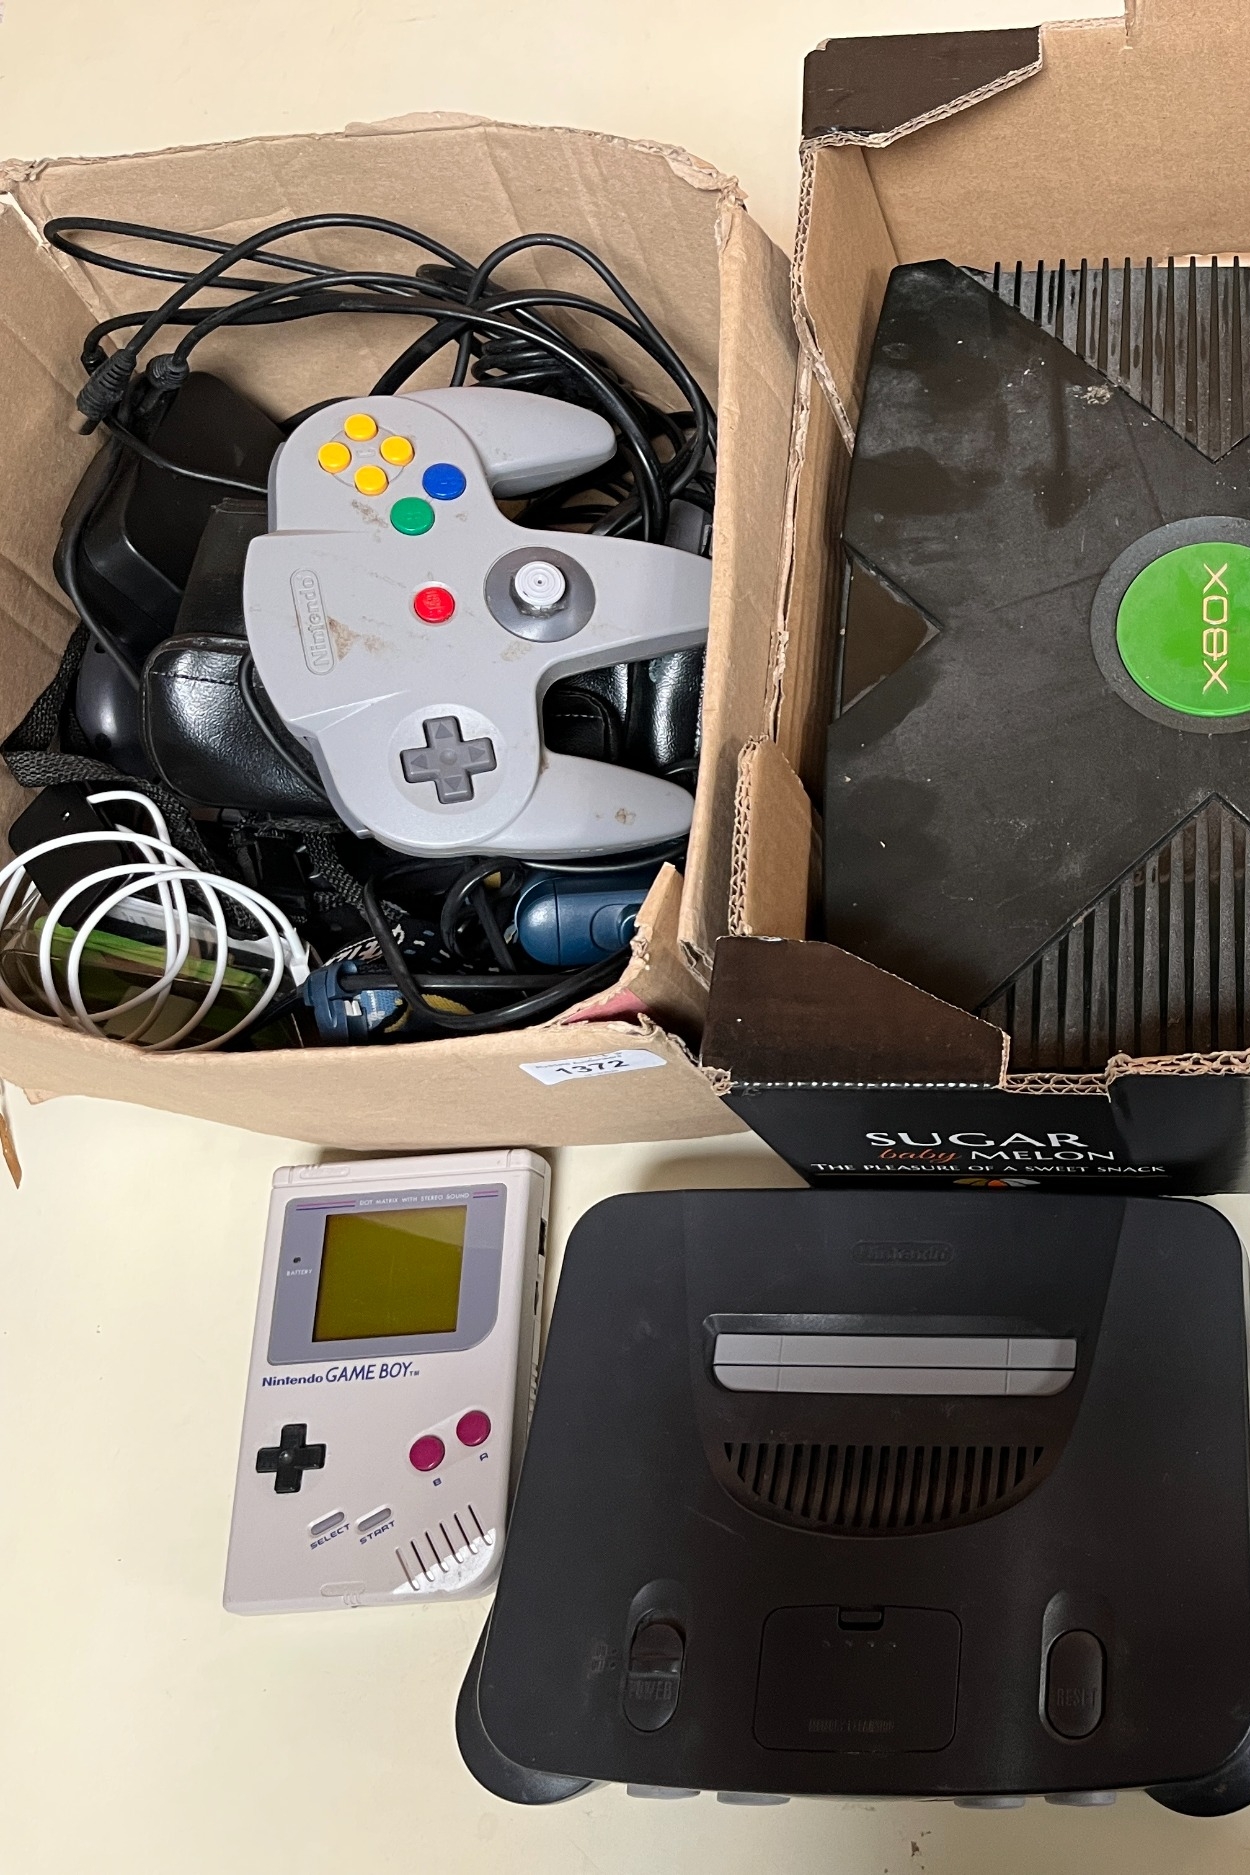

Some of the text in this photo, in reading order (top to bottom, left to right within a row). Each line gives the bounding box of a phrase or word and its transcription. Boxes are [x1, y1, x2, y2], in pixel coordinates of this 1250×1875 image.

[300, 573, 331, 667] Nintendo
[1202, 562, 1229, 694] XBOX
[556, 1060, 630, 1075] 1372
[866, 1132, 1089, 1148] SUGAR
[877, 1148, 1115, 1164] baby MELON
[810, 1163, 857, 1172] THE
[863, 1164, 961, 1172] PLEASURE
[1025, 1165, 1089, 1173] SWEET
[360, 1192, 470, 1206] DOT MATRIX WITH STEREO SOUND
[286, 1268, 313, 1277] BATTERY
[262, 1371, 324, 1388] Nintendo
[325, 1363, 376, 1384] GAME
[479, 1452, 489, 1461] A
[432, 1478, 442, 1486] B
[310, 1522, 351, 1550] SELECT
[359, 1519, 396, 1545] START
